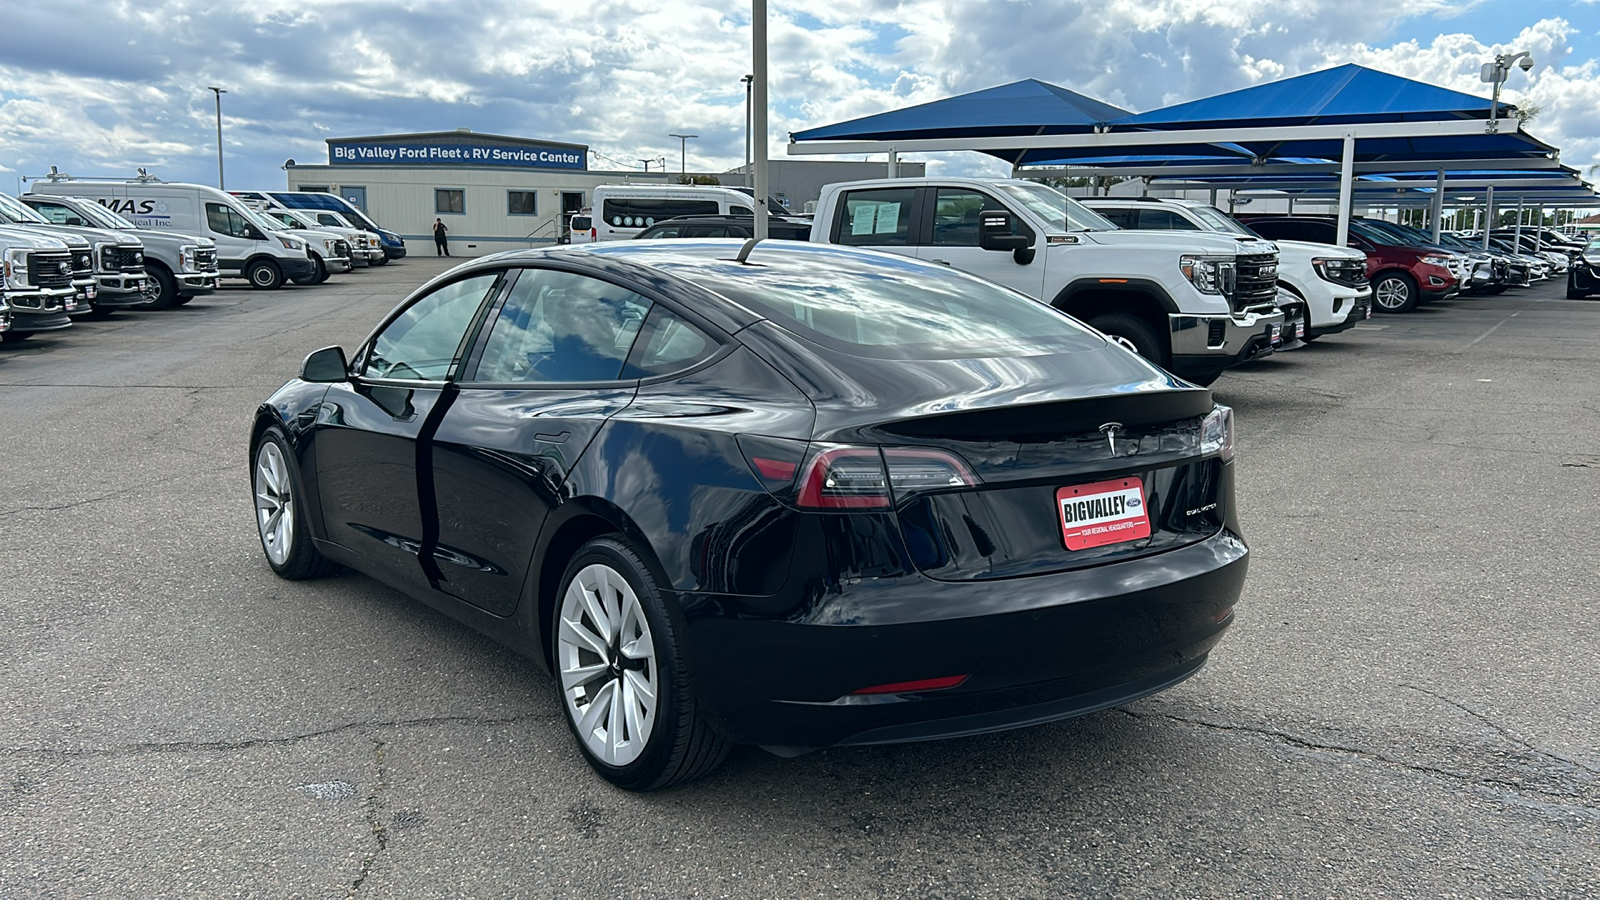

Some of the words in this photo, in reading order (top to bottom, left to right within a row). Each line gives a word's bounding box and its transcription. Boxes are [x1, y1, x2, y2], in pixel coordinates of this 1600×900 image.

[334, 147, 356, 160] Big
[358, 147, 397, 160] Valley
[399, 147, 427, 158] Ford
[430, 147, 461, 158] Fleet
[473, 148, 490, 159] RV
[492, 149, 538, 161] Service
[539, 151, 580, 163] Center
[155, 219, 172, 227] Inc.
[1064, 495, 1126, 523] BIGVALLEY
[1081, 528, 1091, 536] YOUR
[1091, 526, 1109, 535] REGIONAL
[1108, 521, 1134, 532] HEADQUARTERS
